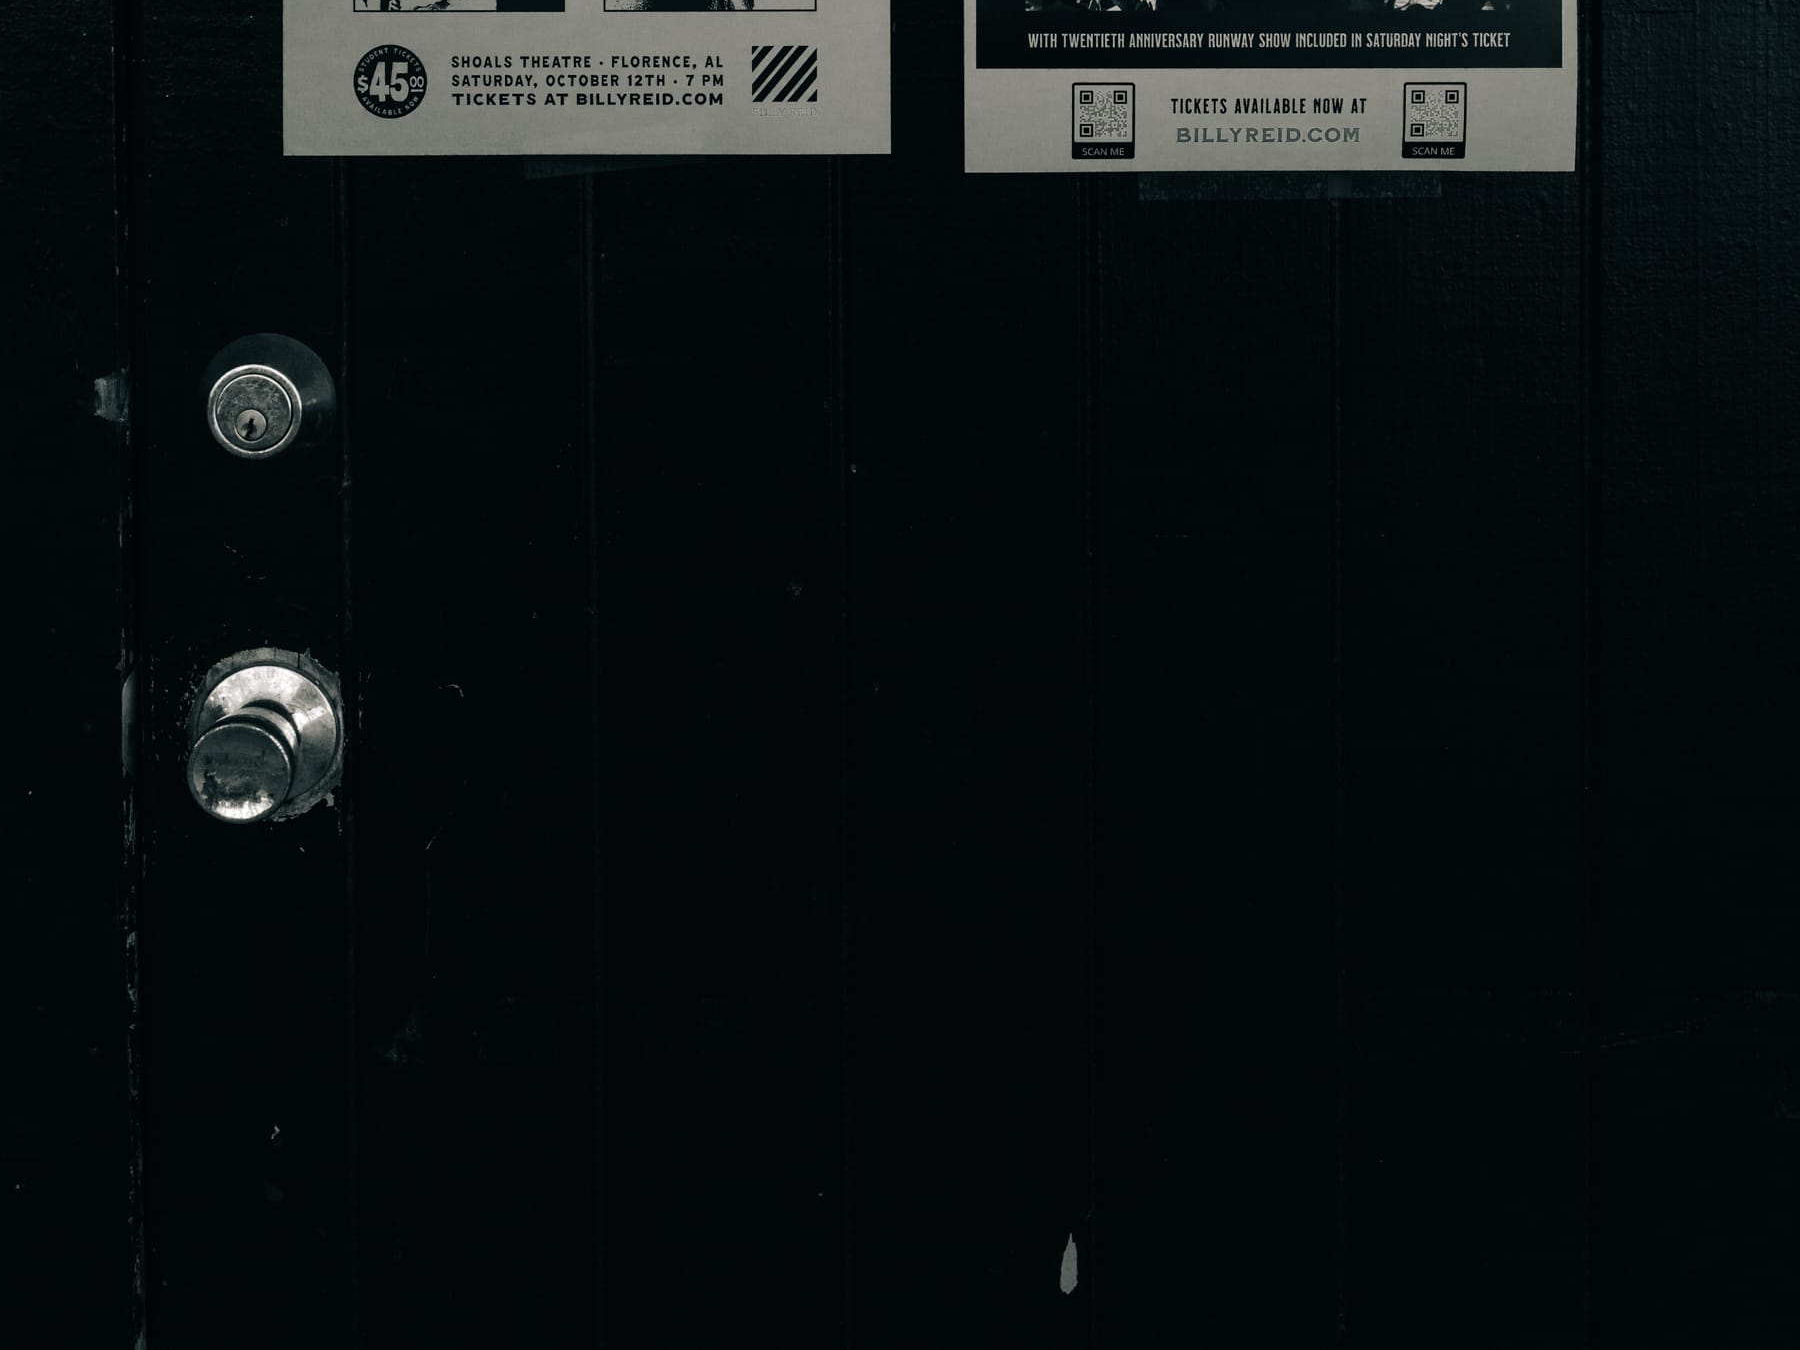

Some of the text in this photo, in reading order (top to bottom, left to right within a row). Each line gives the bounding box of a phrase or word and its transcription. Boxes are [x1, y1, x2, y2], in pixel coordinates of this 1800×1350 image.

[1027, 32, 1511, 49] WITH TWENTIETH ANNIVERSARY RUNWAY SHOW INCLUDED IN SATURDAY NIGHT'S TICKET
[358, 47, 422, 73] STUDENT TICKETS
[451, 55, 513, 69] SHOALS
[519, 55, 592, 69] THEATRE
[611, 55, 697, 70] FLORENCE,
[704, 55, 724, 69] AL
[451, 74, 538, 89] SATURDAY,
[545, 74, 620, 88] OCTOBER
[626, 74, 666, 87] 12TH
[685, 74, 695, 87] 7
[701, 73, 724, 87] PM
[361, 96, 403, 116] AVAILABLE
[451, 92, 723, 106] TICKETS AT BILLYREID.COM
[1170, 97, 1367, 115] TICKETS AVAILABLE NOW AT
[1175, 127, 1361, 144] BILLYREID.COM
[1082, 147, 1125, 156] SCAN ME
[1412, 146, 1456, 156] SCAN ME
